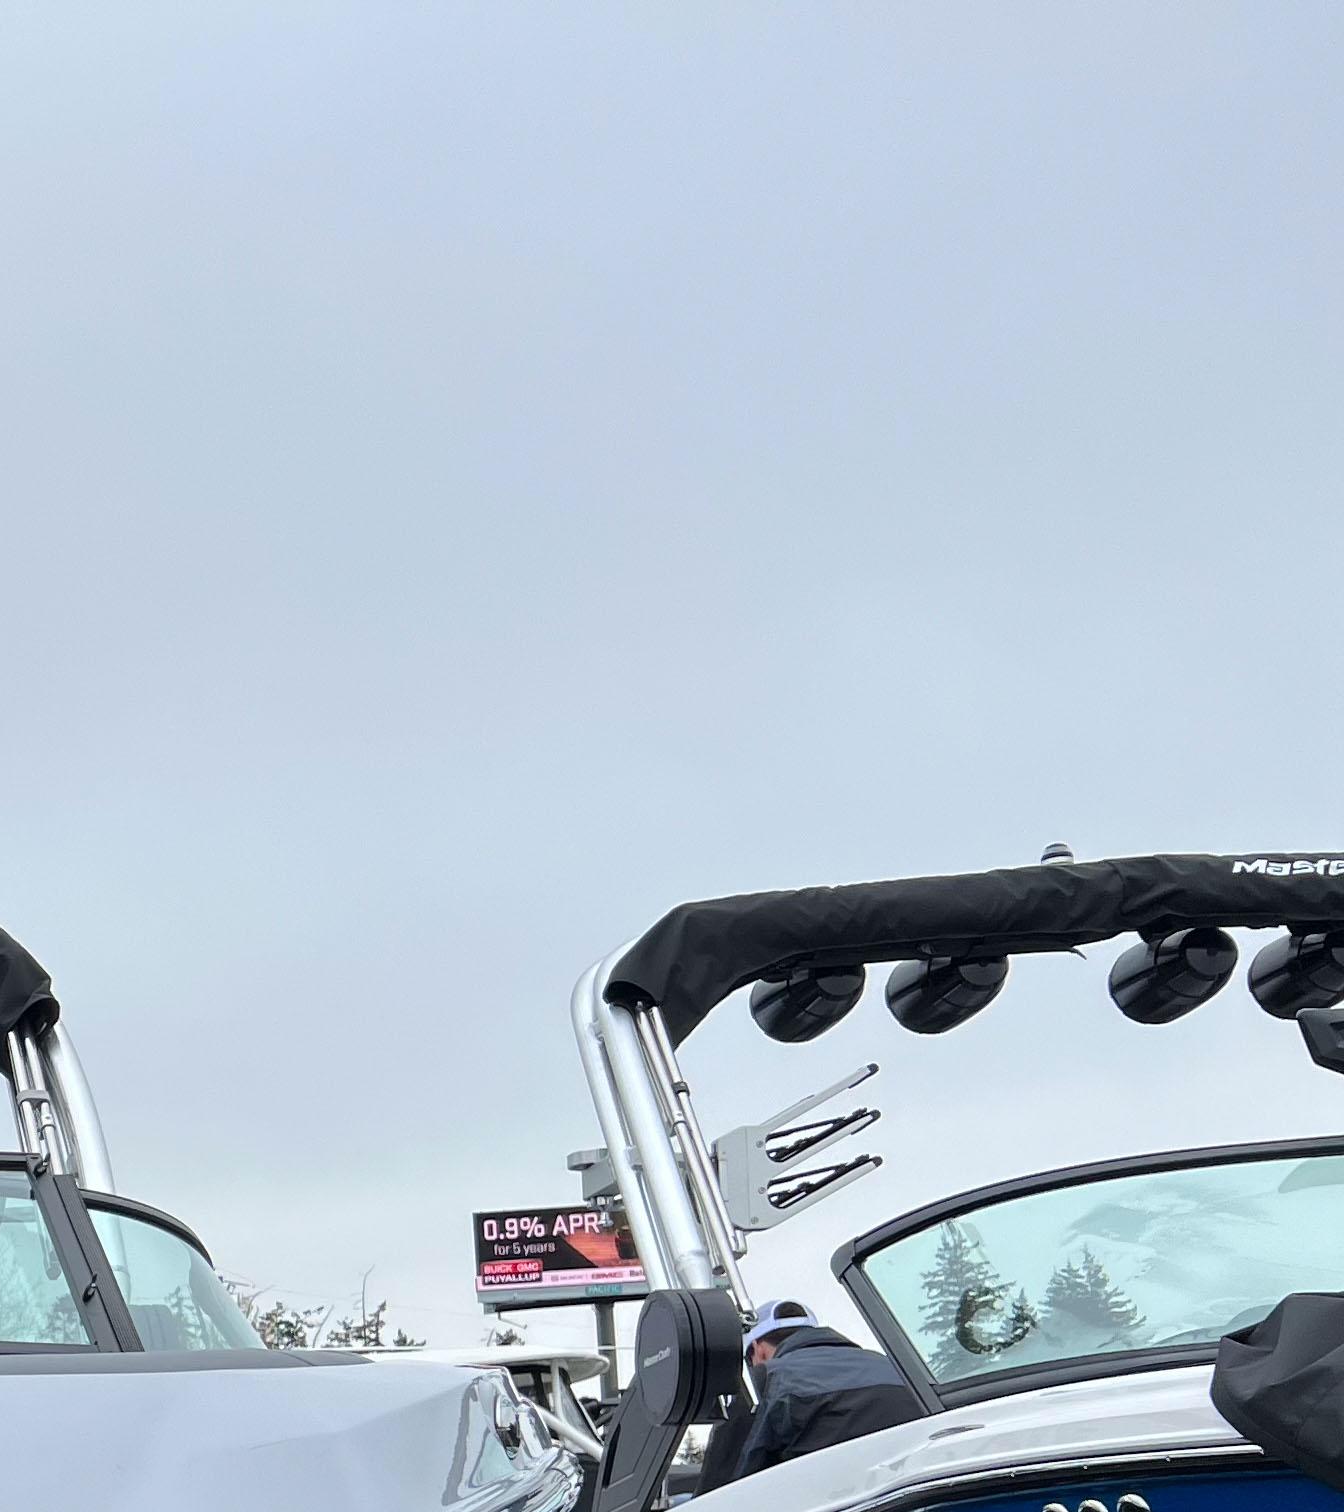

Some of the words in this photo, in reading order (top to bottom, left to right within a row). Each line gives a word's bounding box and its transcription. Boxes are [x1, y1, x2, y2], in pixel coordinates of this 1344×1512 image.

[483, 1216, 545, 1241] 0.9%
[552, 1212, 600, 1237] APR
[493, 1243, 510, 1256] for
[512, 1242, 521, 1255] 5
[523, 1242, 556, 1256] years
[484, 1272, 540, 1284] PUYALLUP
